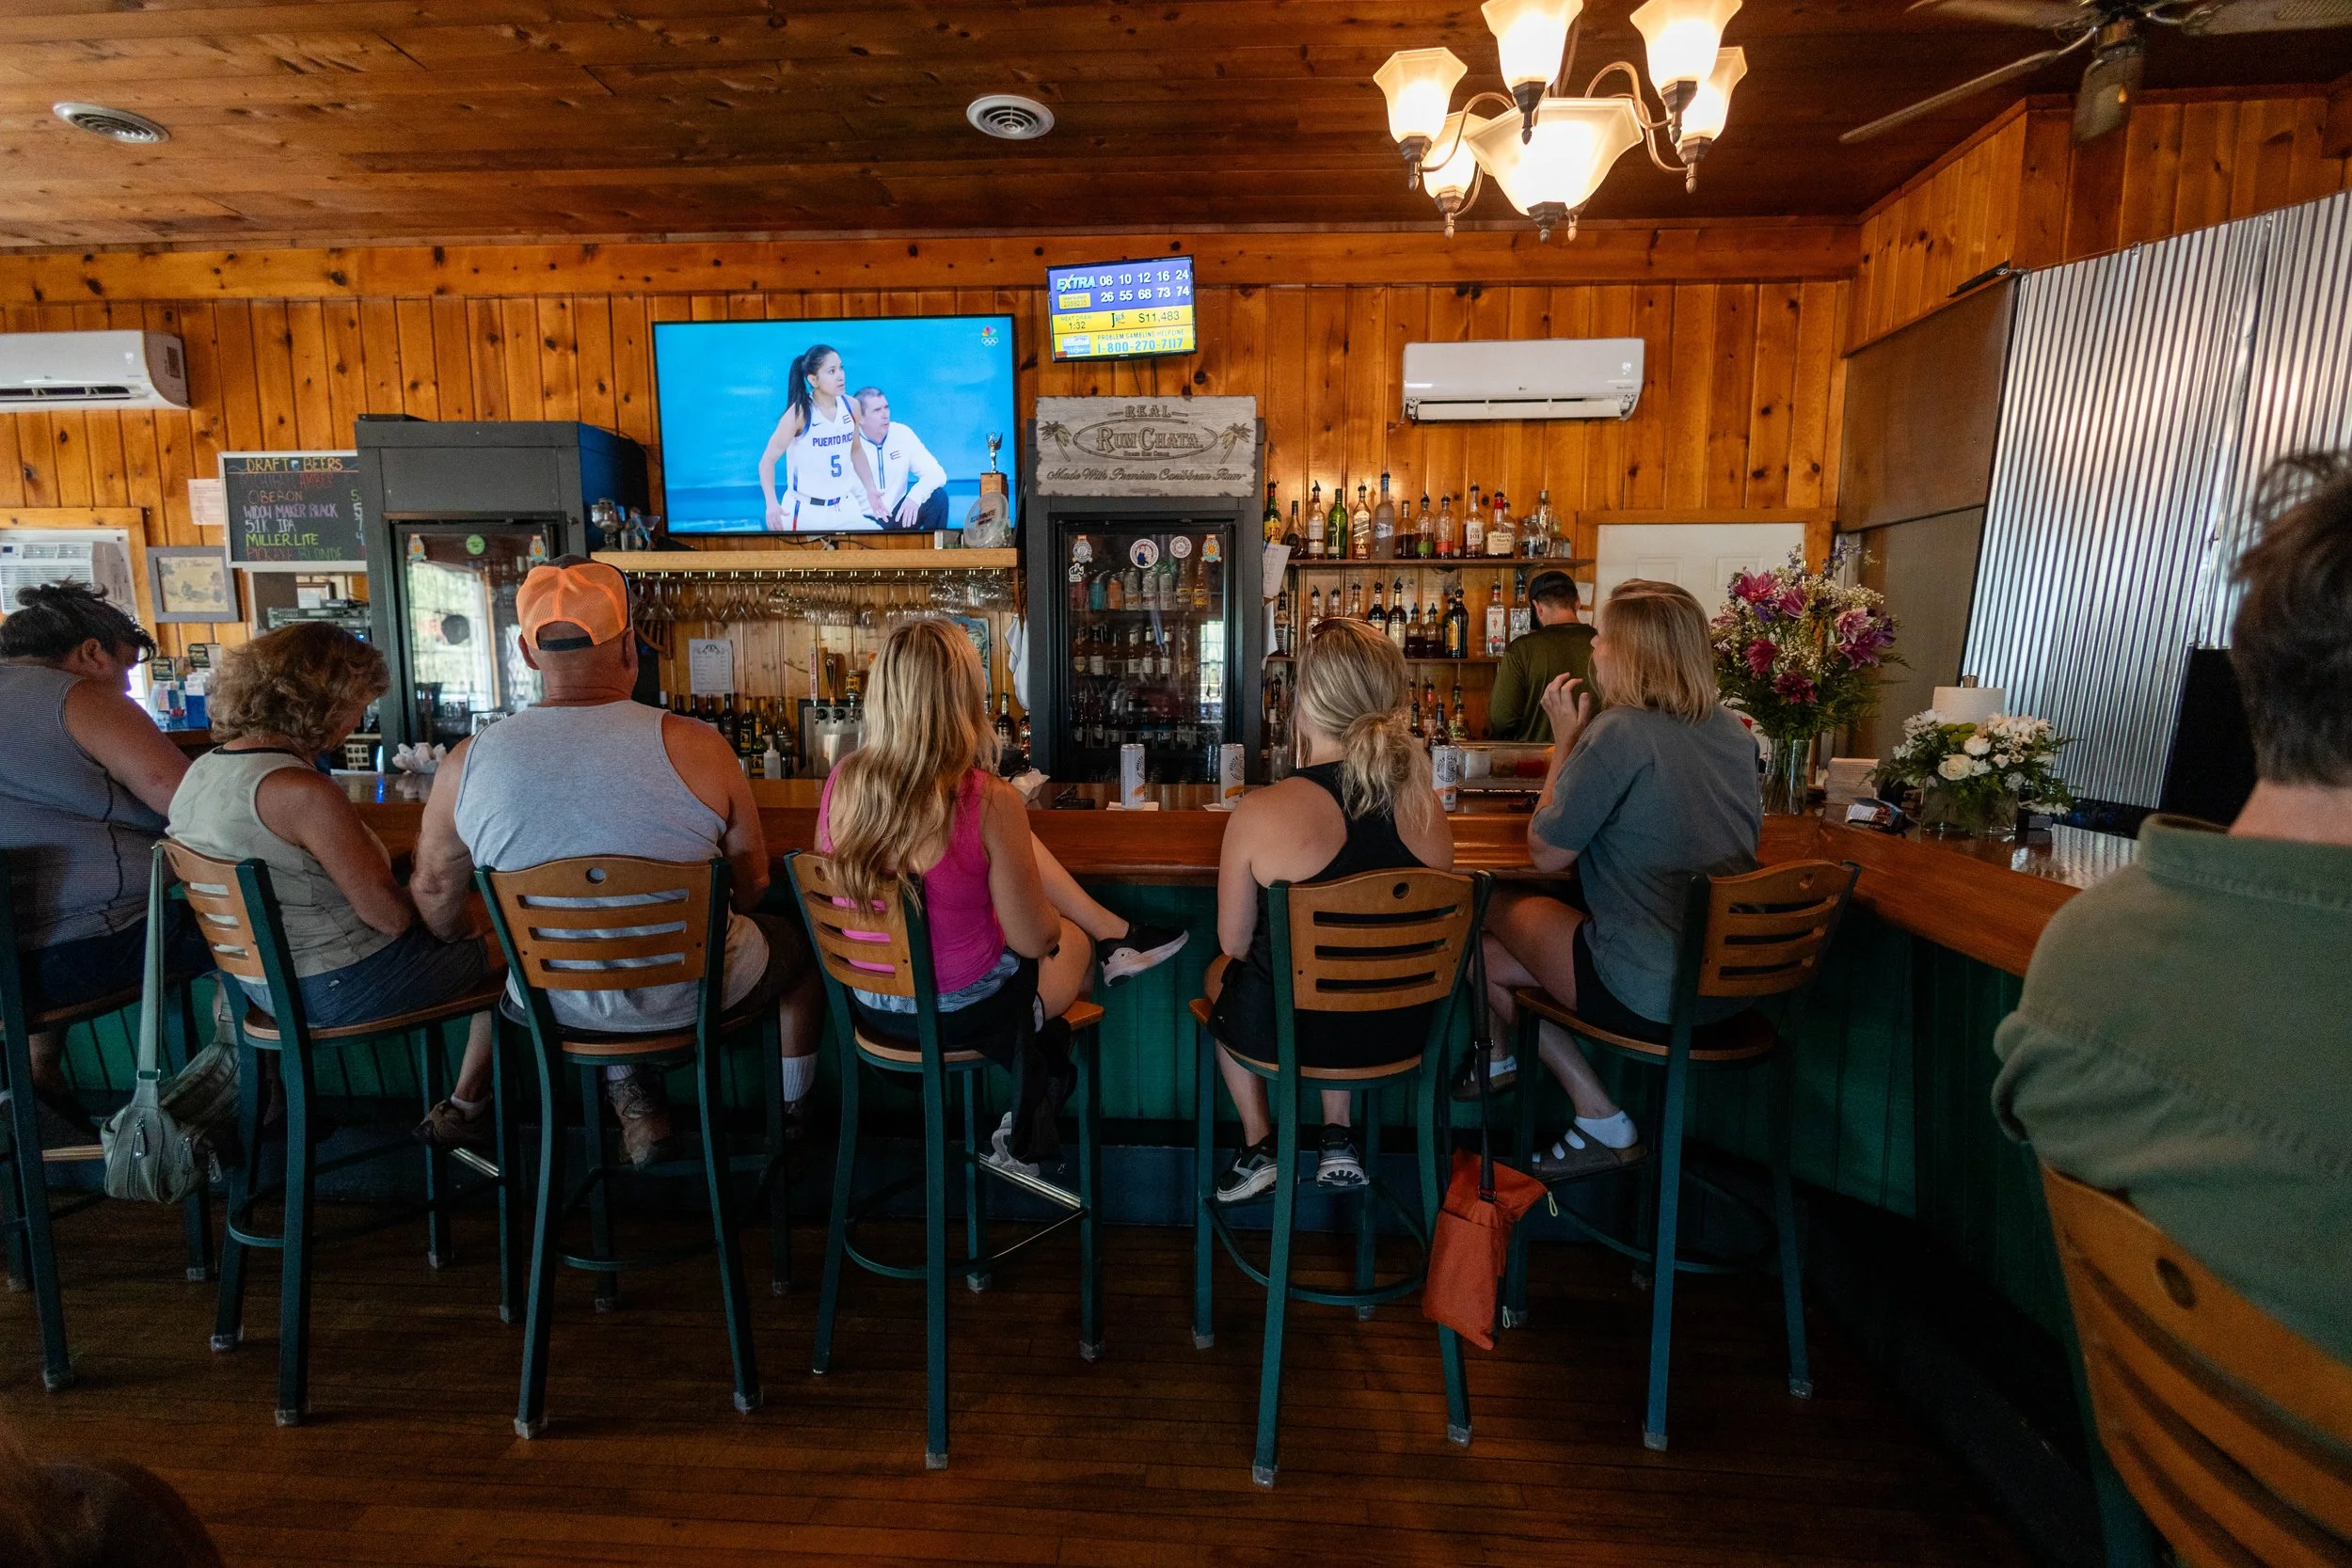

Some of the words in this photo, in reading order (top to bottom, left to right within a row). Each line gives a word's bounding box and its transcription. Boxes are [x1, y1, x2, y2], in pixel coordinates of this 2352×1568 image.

[1057, 275, 1096, 292] EXTRA
[1100, 276, 1113, 286] 08
[1120, 274, 1132, 284] 10
[1138, 273, 1152, 283] 12
[1157, 271, 1170, 282] 16
[1176, 270, 1189, 280] 24
[1101, 293, 1114, 303] 26
[1120, 291, 1133, 301] 55
[1138, 289, 1152, 300] 68
[1157, 288, 1170, 298] 73
[1177, 286, 1190, 297] 74
[1097, 338, 1183, 354] 1-800-270-7117
[1125, 404, 1171, 418] REAL
[812, 436, 841, 447] PUERTO
[246, 458, 289, 471] DRAFT
[303, 457, 342, 471] BEERS
[831, 455, 841, 477] 5
[1046, 468, 1081, 481] Made
[1082, 468, 1107, 481] With
[1109, 467, 1157, 481] Premium
[1158, 467, 1212, 481] Caribbean
[248, 490, 303, 504] OBERON
[275, 504, 306, 517] MAKER
[309, 503, 339, 517] BLACK
[245, 518, 270, 533] 51K
[277, 518, 296, 532] IPA
[246, 533, 294, 546] MILLER
[294, 533, 319, 546] LITE
